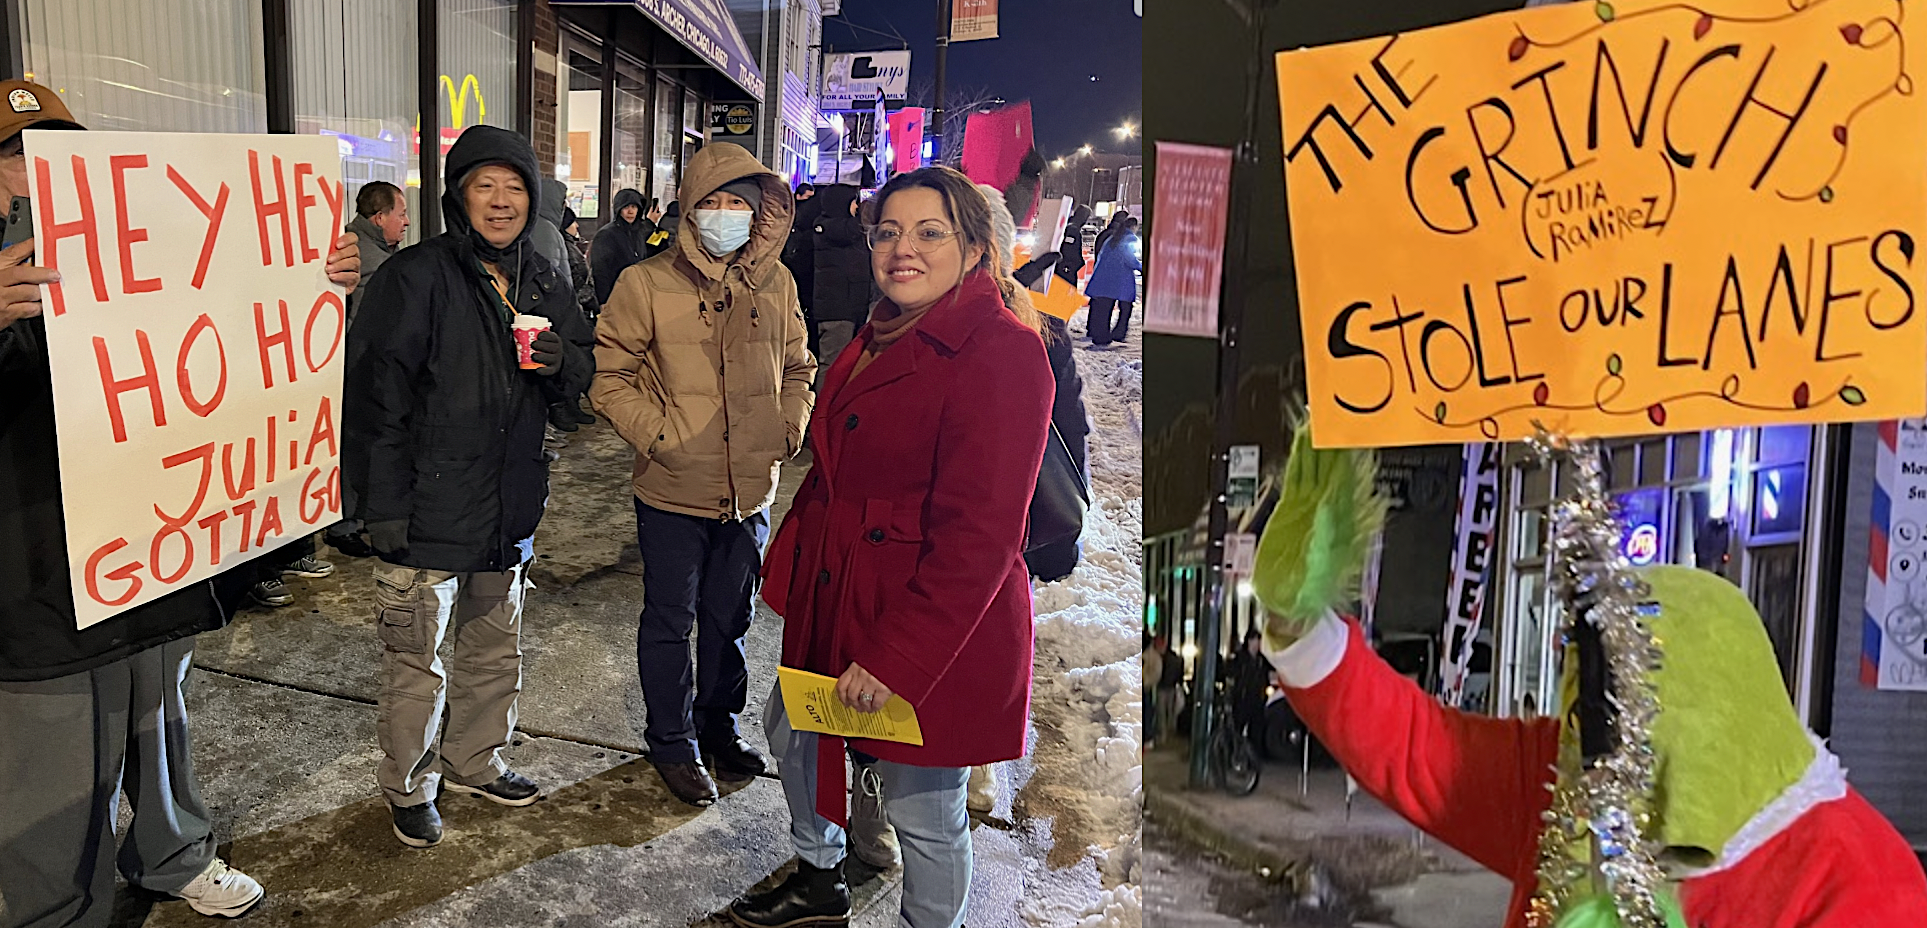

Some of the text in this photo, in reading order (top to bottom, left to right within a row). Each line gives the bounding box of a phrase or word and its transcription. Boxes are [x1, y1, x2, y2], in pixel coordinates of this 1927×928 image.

[661, 0, 686, 40] ARCHER,
[687, 21, 711, 59] CHICAGO,
[711, 41, 716, 59] IL
[728, 116, 753, 124] Tio Luis
[1286, 34, 1439, 193] THE
[1406, 37, 1828, 235] GRINCH
[34, 149, 343, 317] HEY HEY
[1560, 277, 1648, 333] OUR
[1658, 230, 1915, 371] LANES
[93, 290, 344, 443] HO HO
[84, 466, 341, 606] GOTTA GO
